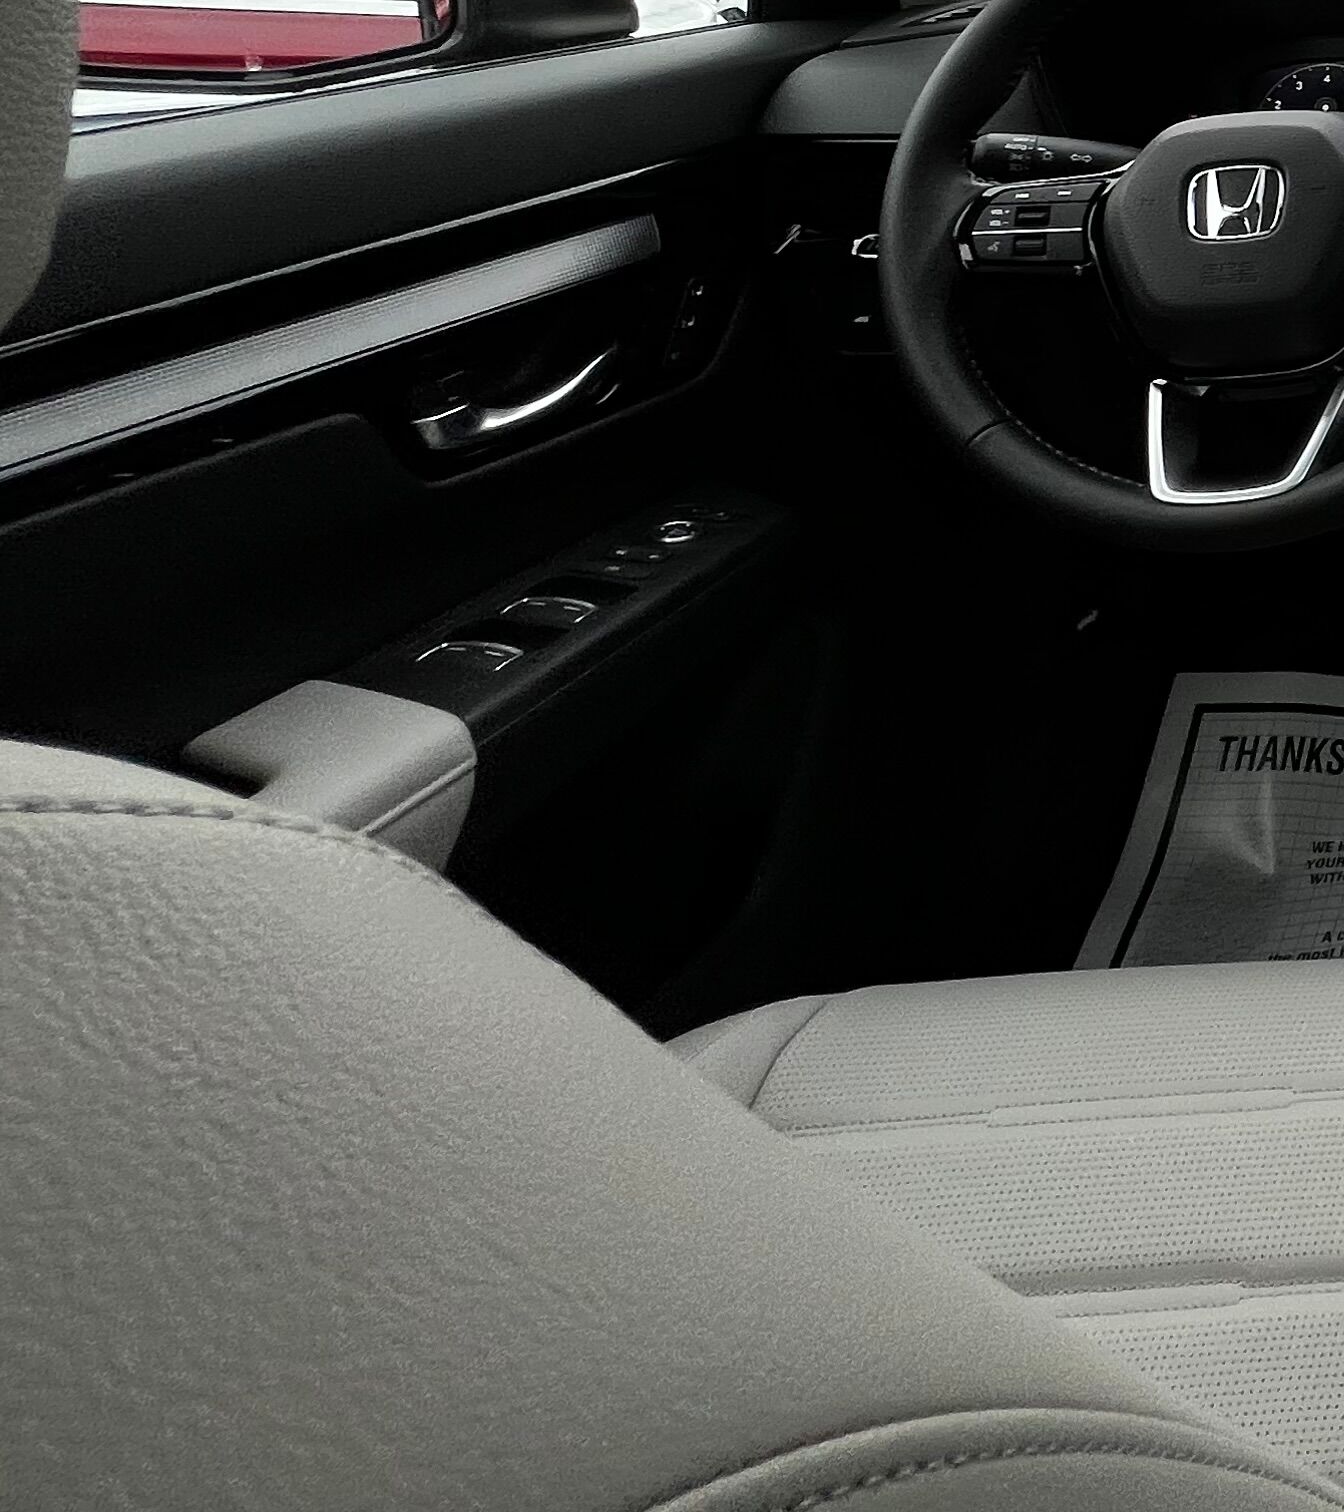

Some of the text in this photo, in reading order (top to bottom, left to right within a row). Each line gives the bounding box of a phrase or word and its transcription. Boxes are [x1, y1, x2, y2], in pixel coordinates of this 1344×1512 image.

[1323, 74, 1332, 85] 4
[1295, 81, 1304, 91] 3
[1274, 100, 1283, 110] 2
[1311, 840, 1336, 854] WE
[1321, 931, 1332, 944] A
[1296, 948, 1335, 961] most
